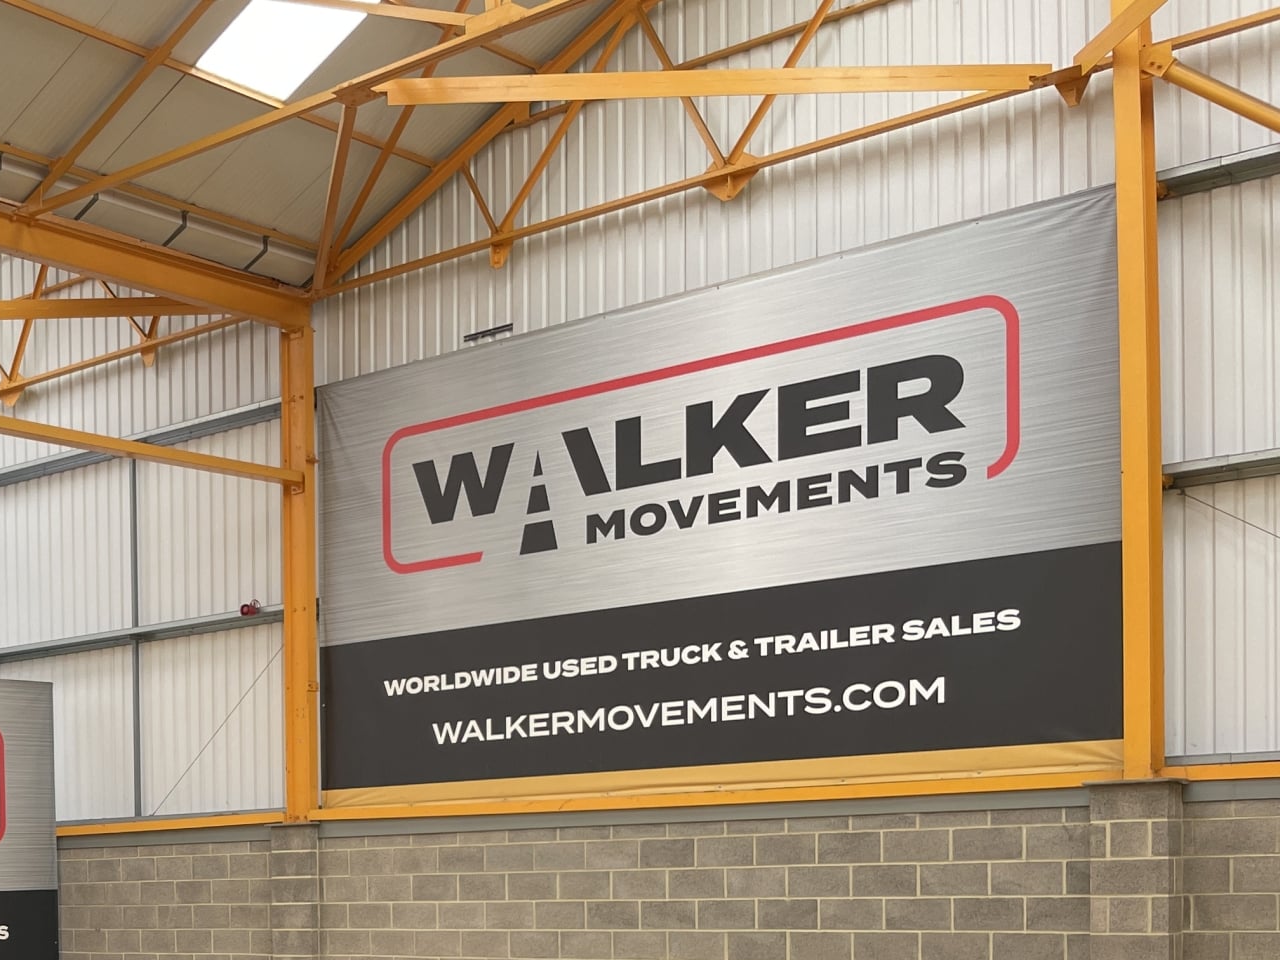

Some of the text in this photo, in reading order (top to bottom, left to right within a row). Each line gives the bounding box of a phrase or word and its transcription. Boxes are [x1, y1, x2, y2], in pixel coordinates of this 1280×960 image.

[412, 353, 967, 555] WALKER
[586, 451, 968, 545] MOVEMENTS
[383, 608, 1023, 697] WORLDWIDE USED TRUCK & TRAILER SALES
[432, 676, 948, 746] WALKERMOVEMENTS.COM
